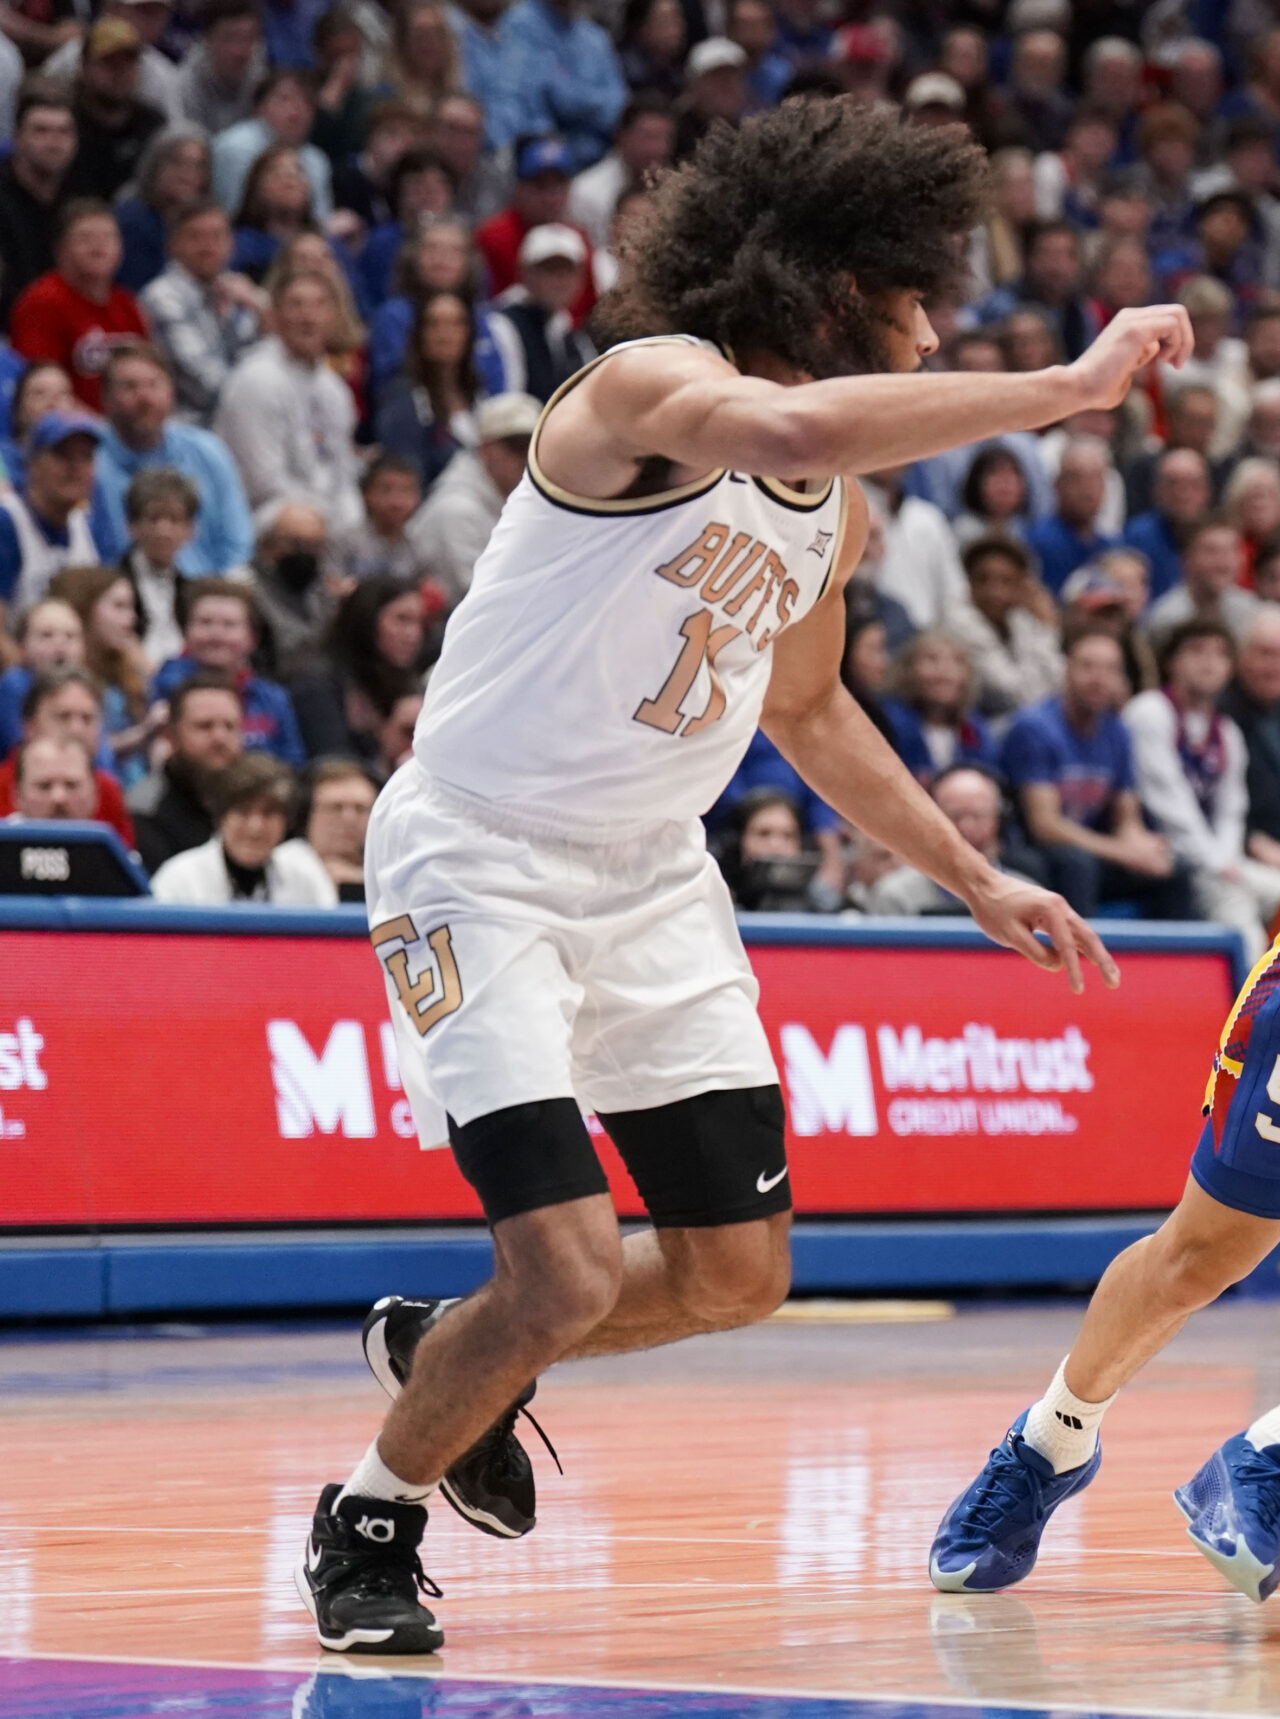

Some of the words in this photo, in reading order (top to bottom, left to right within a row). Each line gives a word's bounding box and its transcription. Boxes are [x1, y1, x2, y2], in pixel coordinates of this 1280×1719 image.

[654, 521, 800, 652] BUFFS
[369, 912, 464, 1037] CU
[876, 1020, 1095, 1093] Meritrust
[887, 1097, 979, 1137] CREDIT
